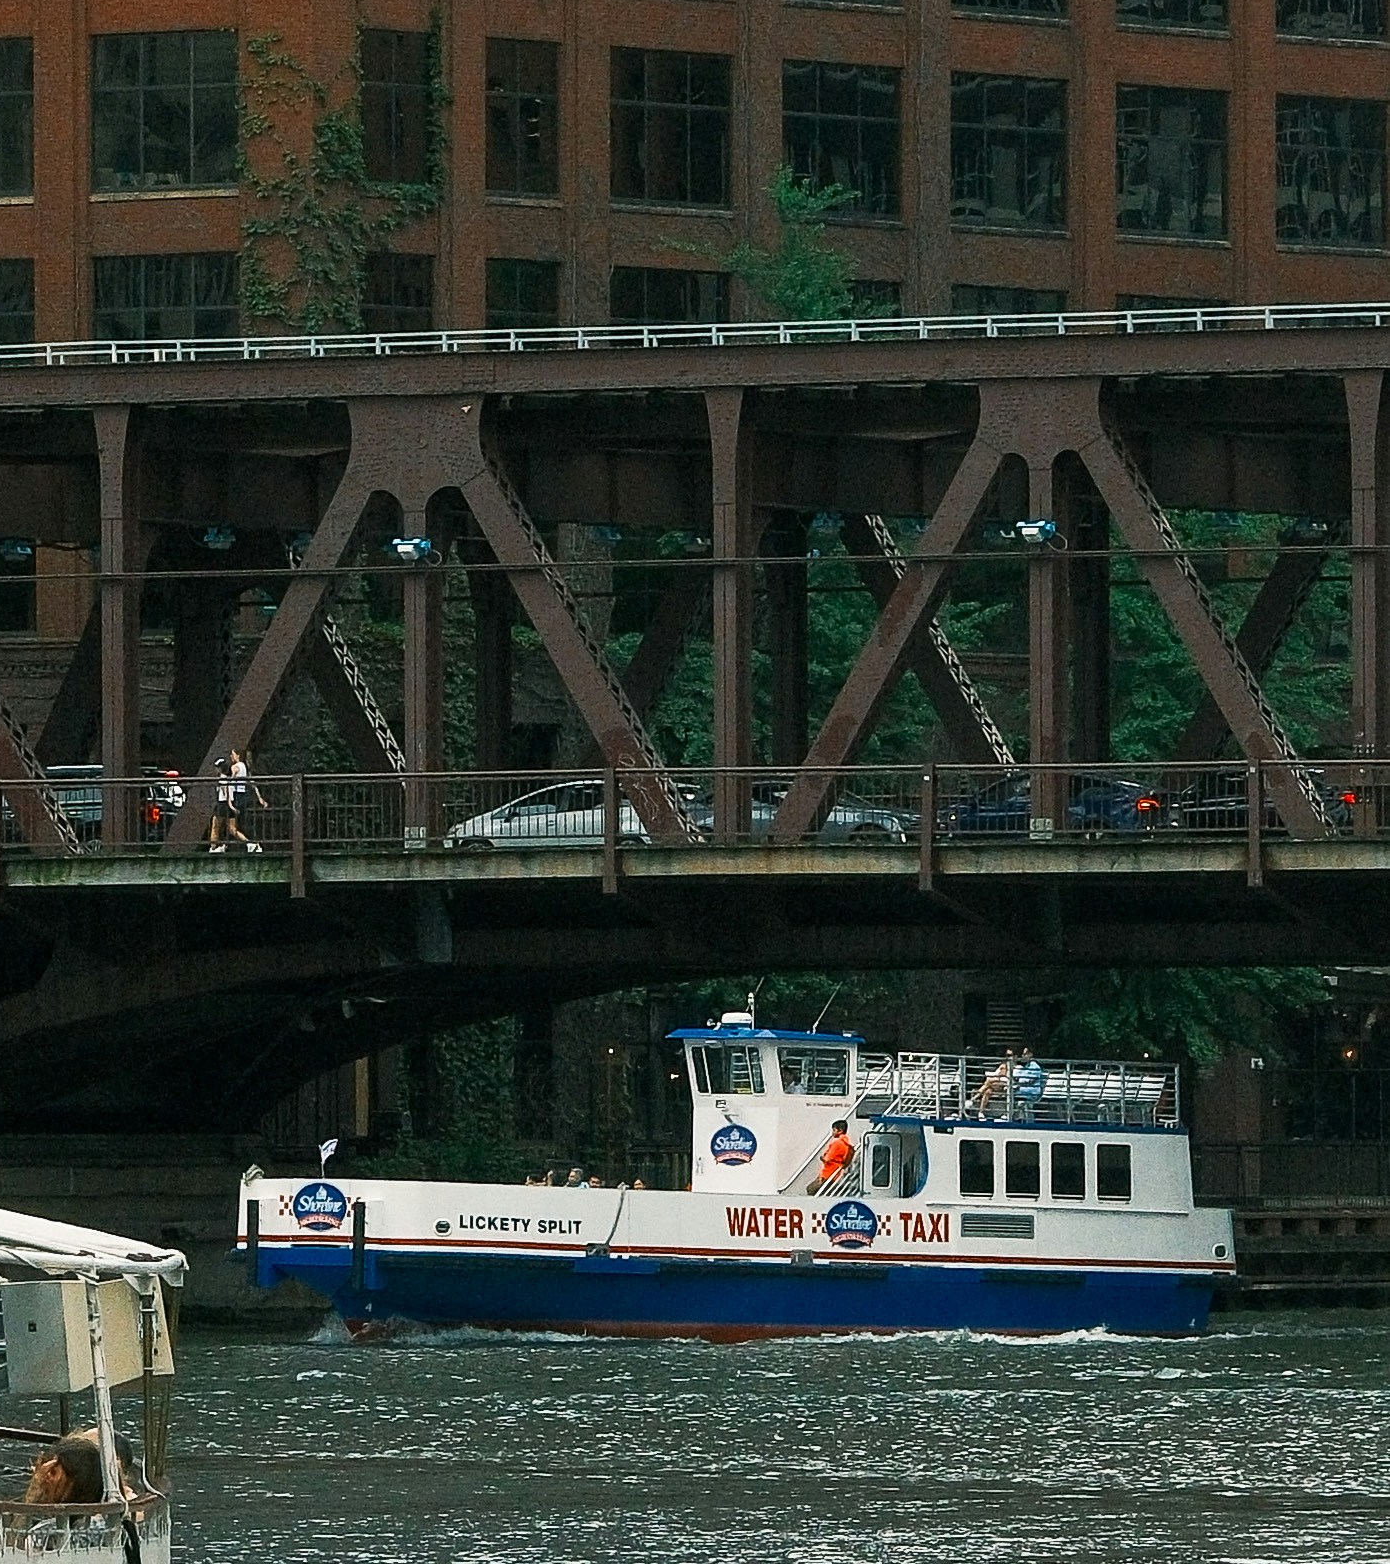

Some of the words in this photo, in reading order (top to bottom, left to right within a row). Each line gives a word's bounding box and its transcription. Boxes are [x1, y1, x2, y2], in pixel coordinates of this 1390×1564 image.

[459, 1214, 531, 1232] LICKETY
[537, 1219, 583, 1235] SPLIT
[725, 1206, 804, 1239] WATER
[899, 1211, 950, 1243] TAXI
